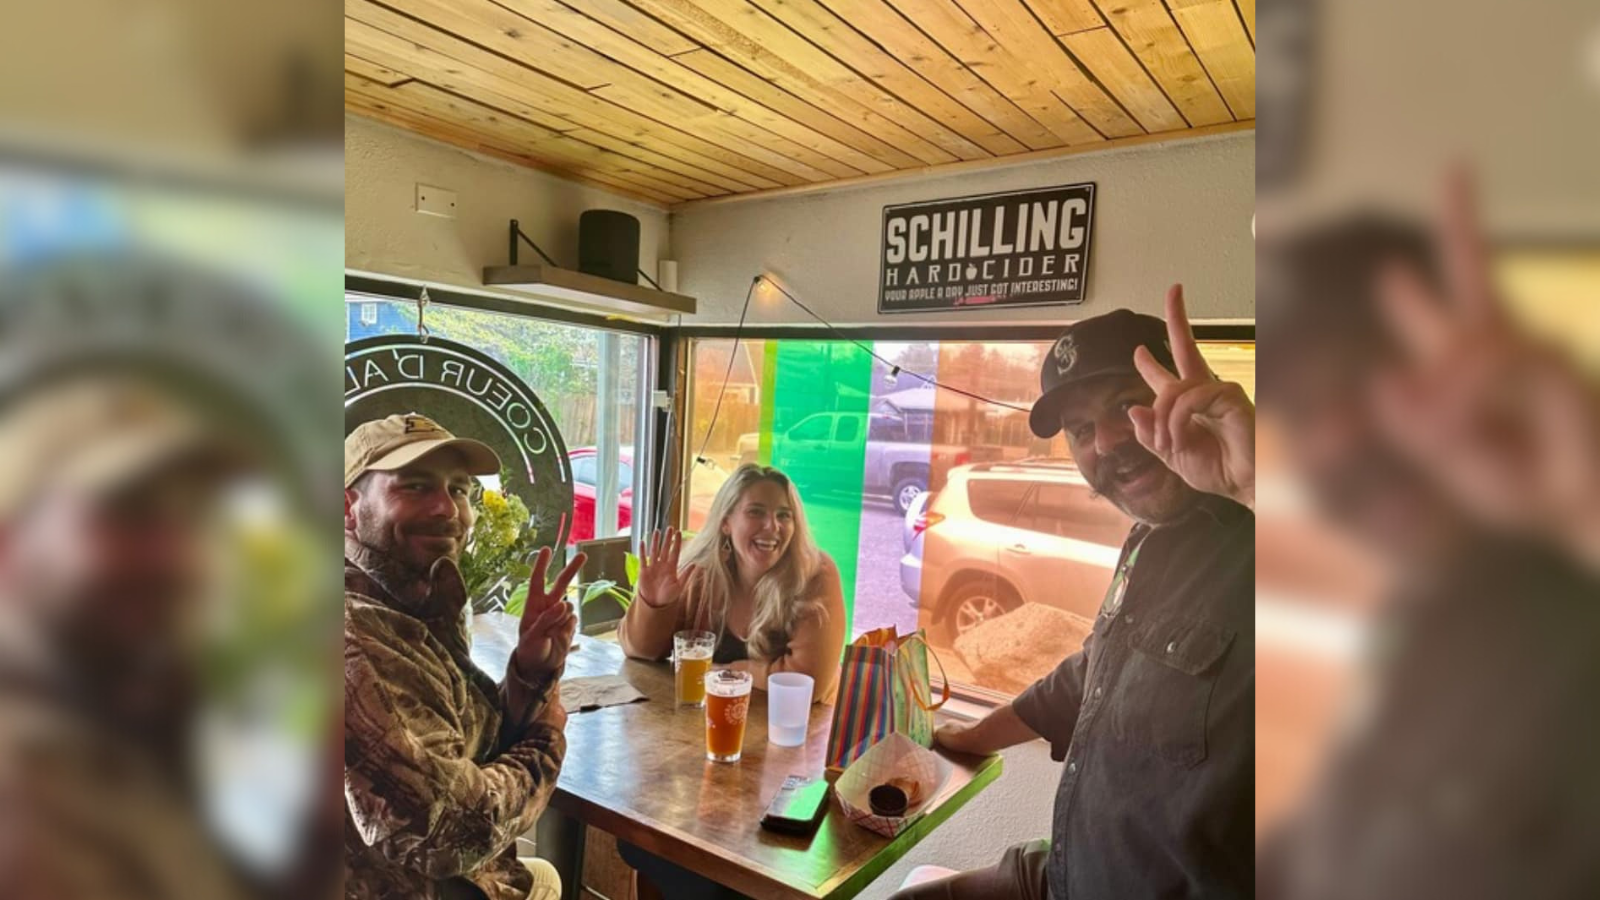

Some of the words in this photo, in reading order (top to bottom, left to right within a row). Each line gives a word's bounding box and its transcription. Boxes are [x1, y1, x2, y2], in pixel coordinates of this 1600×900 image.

[886, 198, 1087, 264] SCHILLING
[886, 264, 962, 286] HARD
[982, 253, 1080, 280] CIDER
[885, 289, 907, 301] YOUR
[908, 287, 936, 300] APPLE
[937, 286, 943, 298] A
[945, 285, 963, 298] DAY
[965, 283, 988, 297] JUST
[991, 282, 1009, 295] GOT
[1010, 278, 1078, 295] INTERESTING!
